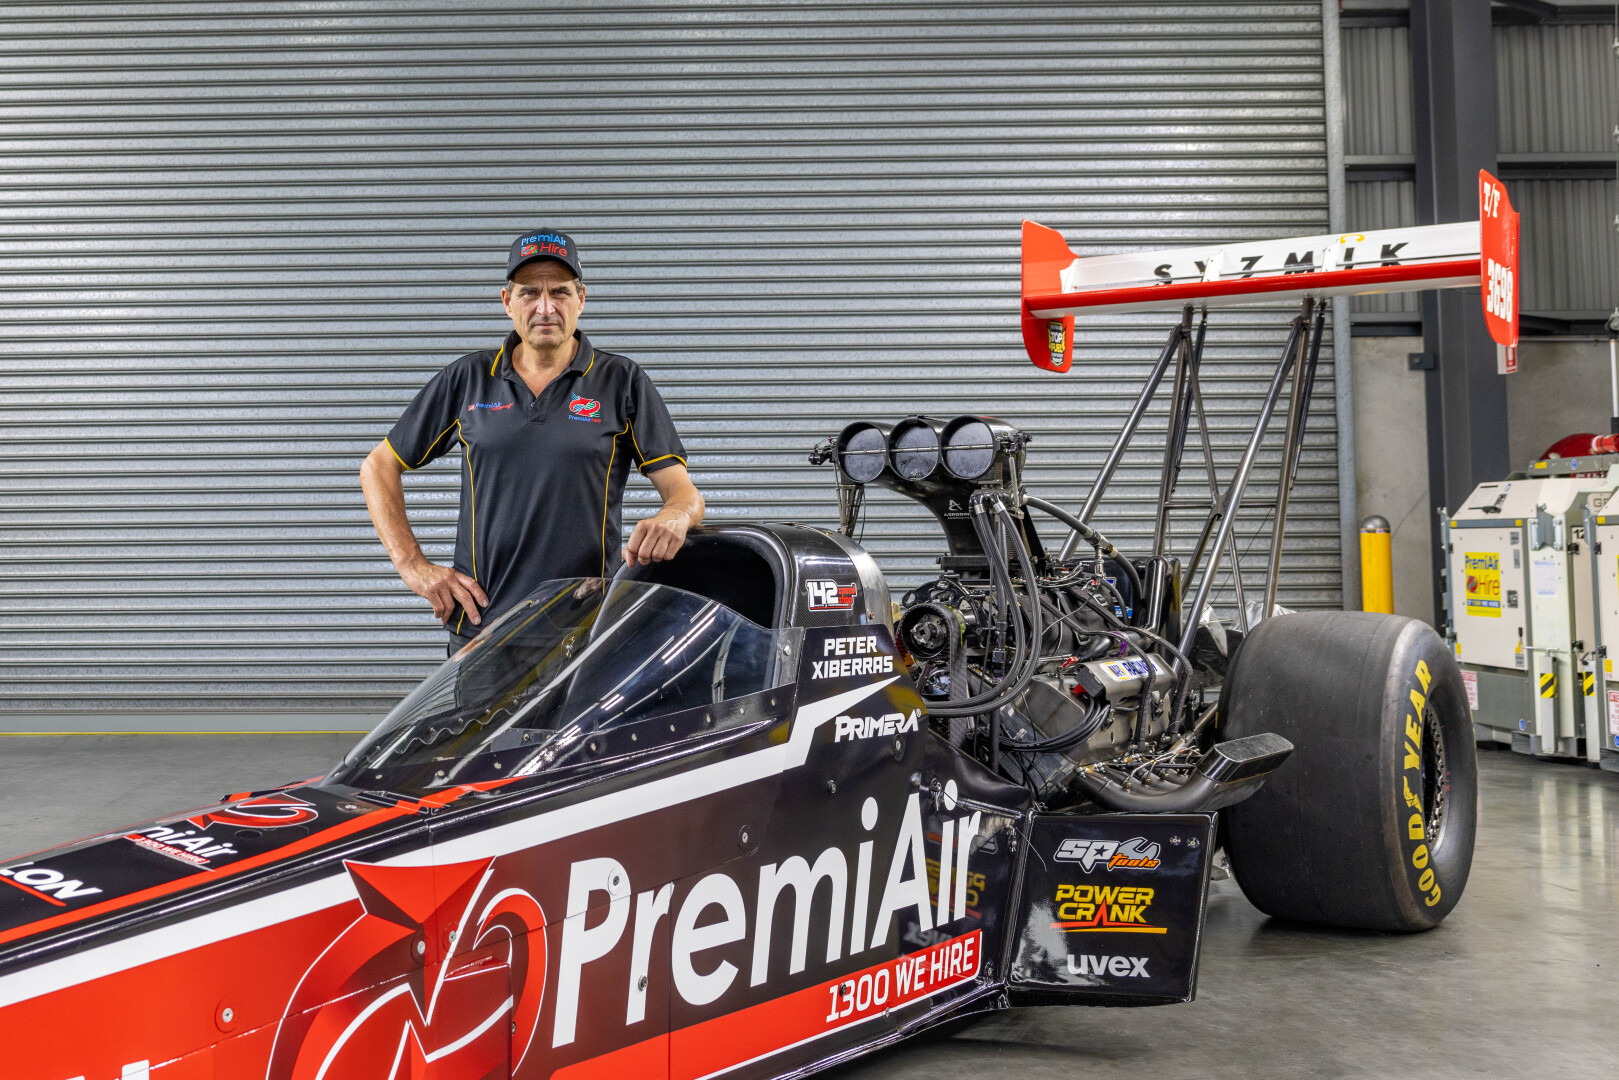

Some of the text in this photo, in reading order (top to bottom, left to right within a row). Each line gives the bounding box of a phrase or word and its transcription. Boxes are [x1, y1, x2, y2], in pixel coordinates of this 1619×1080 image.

[1483, 181, 1500, 218] T/F
[521, 234, 567, 246] PremiAir
[540, 243, 567, 257] Hire
[1465, 555, 1499, 570] PremiAir
[806, 581, 839, 608] 142
[1479, 574, 1500, 596] Hire
[824, 636, 877, 656] PETER
[812, 656, 893, 680] XIBERRAS
[1108, 852, 1160, 869] tools
[1055, 884, 1155, 906] POWER
[552, 779, 982, 1048] PremiAir
[1058, 899, 1147, 923] CRANK
[1067, 954, 1151, 978] uvex
[826, 937, 975, 1023] 1300 WE HIRE
